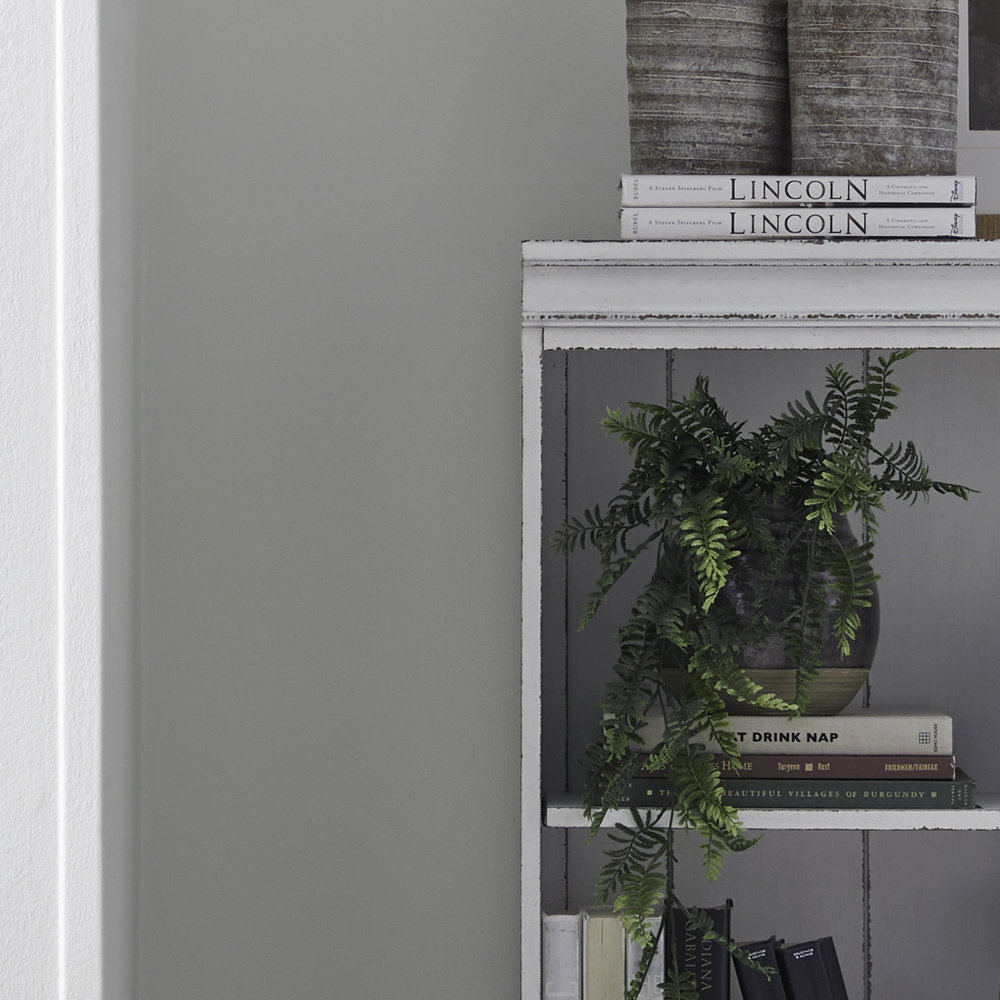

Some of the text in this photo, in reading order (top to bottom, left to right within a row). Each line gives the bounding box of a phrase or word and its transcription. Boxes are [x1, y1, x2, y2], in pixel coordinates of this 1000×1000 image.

[730, 178, 868, 201] LINCOLN
[730, 212, 868, 234] LINCOLN
[752, 732, 800, 742] DRINK
[807, 732, 838, 742] NAP
[778, 762, 800, 772] Turgeon
[818, 762, 830, 771] Rust
[701, 940, 712, 991] DIANA
